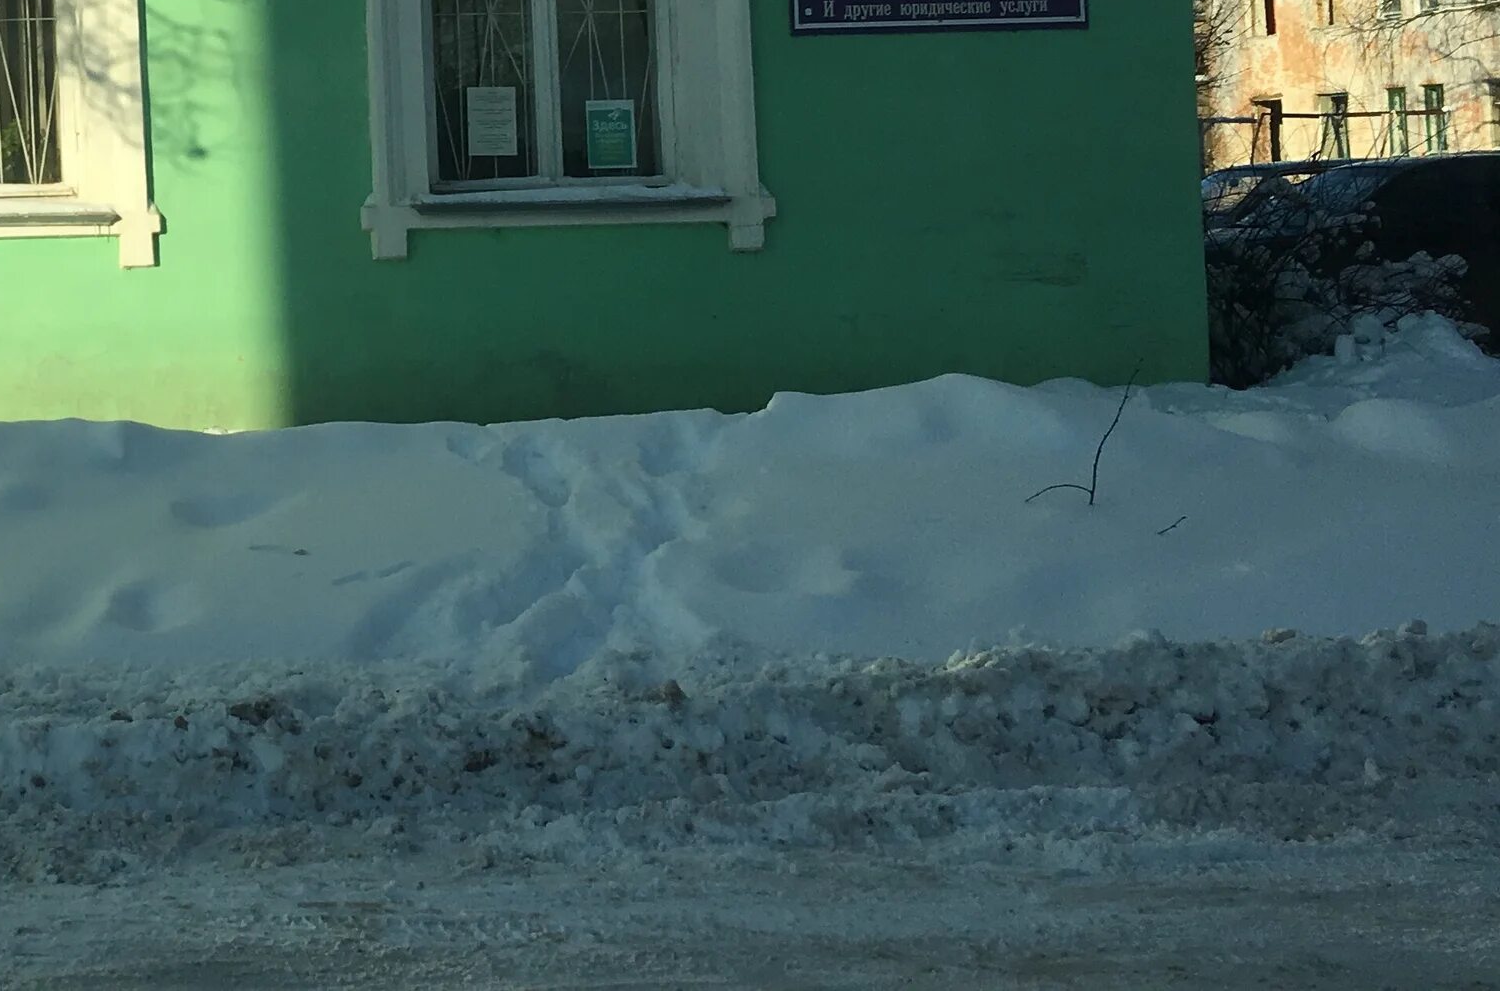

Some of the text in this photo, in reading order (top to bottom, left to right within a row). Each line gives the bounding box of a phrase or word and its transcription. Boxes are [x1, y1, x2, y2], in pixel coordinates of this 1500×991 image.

[823, 0, 1048, 20] И другие юридические услуги
